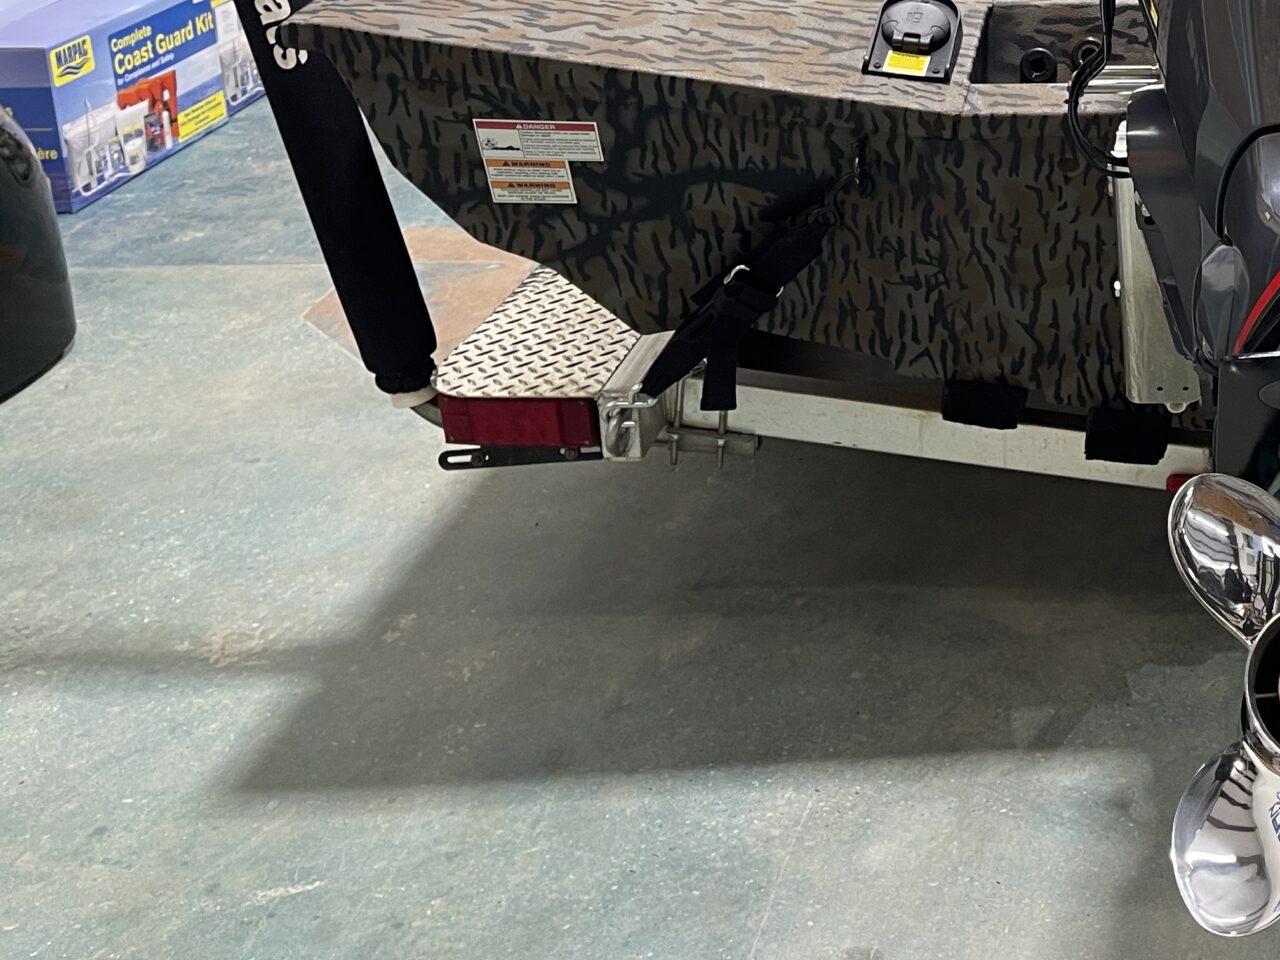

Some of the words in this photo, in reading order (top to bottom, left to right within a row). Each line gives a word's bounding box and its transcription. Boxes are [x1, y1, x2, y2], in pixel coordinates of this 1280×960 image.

[110, 25, 152, 52] Complete
[114, 40, 155, 75] Coast
[155, 20, 194, 55] Guard
[195, 11, 214, 36] Kit
[54, 39, 88, 68] MARPAC
